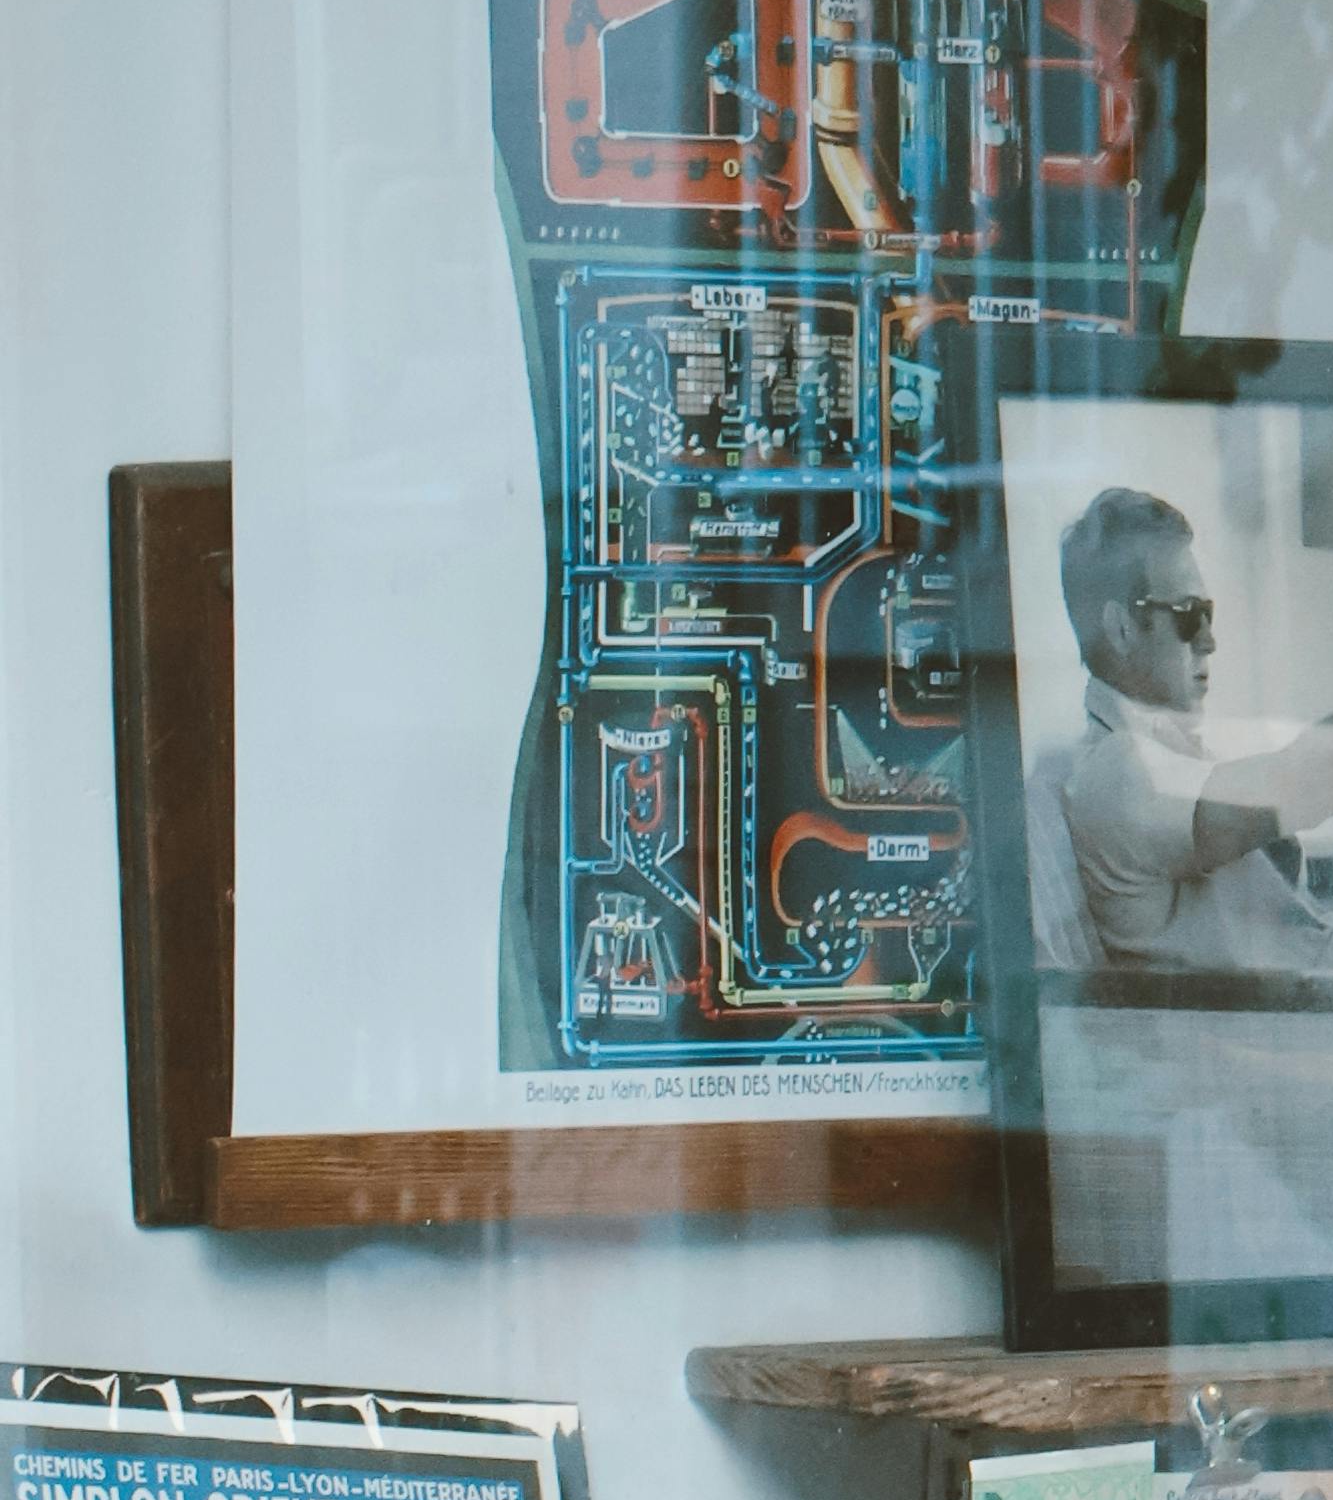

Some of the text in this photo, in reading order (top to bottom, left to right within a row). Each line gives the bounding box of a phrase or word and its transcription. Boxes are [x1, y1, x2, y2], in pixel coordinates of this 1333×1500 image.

[975, 299, 1031, 320] Magen
[876, 840, 922, 858] Darm
[586, 1084, 604, 1101] zu
[655, 1076, 683, 1099] DAS
[689, 1074, 737, 1098] LEBEN
[742, 1074, 770, 1097] DES
[778, 1073, 863, 1096] MENSCHEN
[14, 1453, 107, 1481] CHEMINS
[117, 1460, 147, 1483] DE
[157, 1462, 198, 1487] FER
